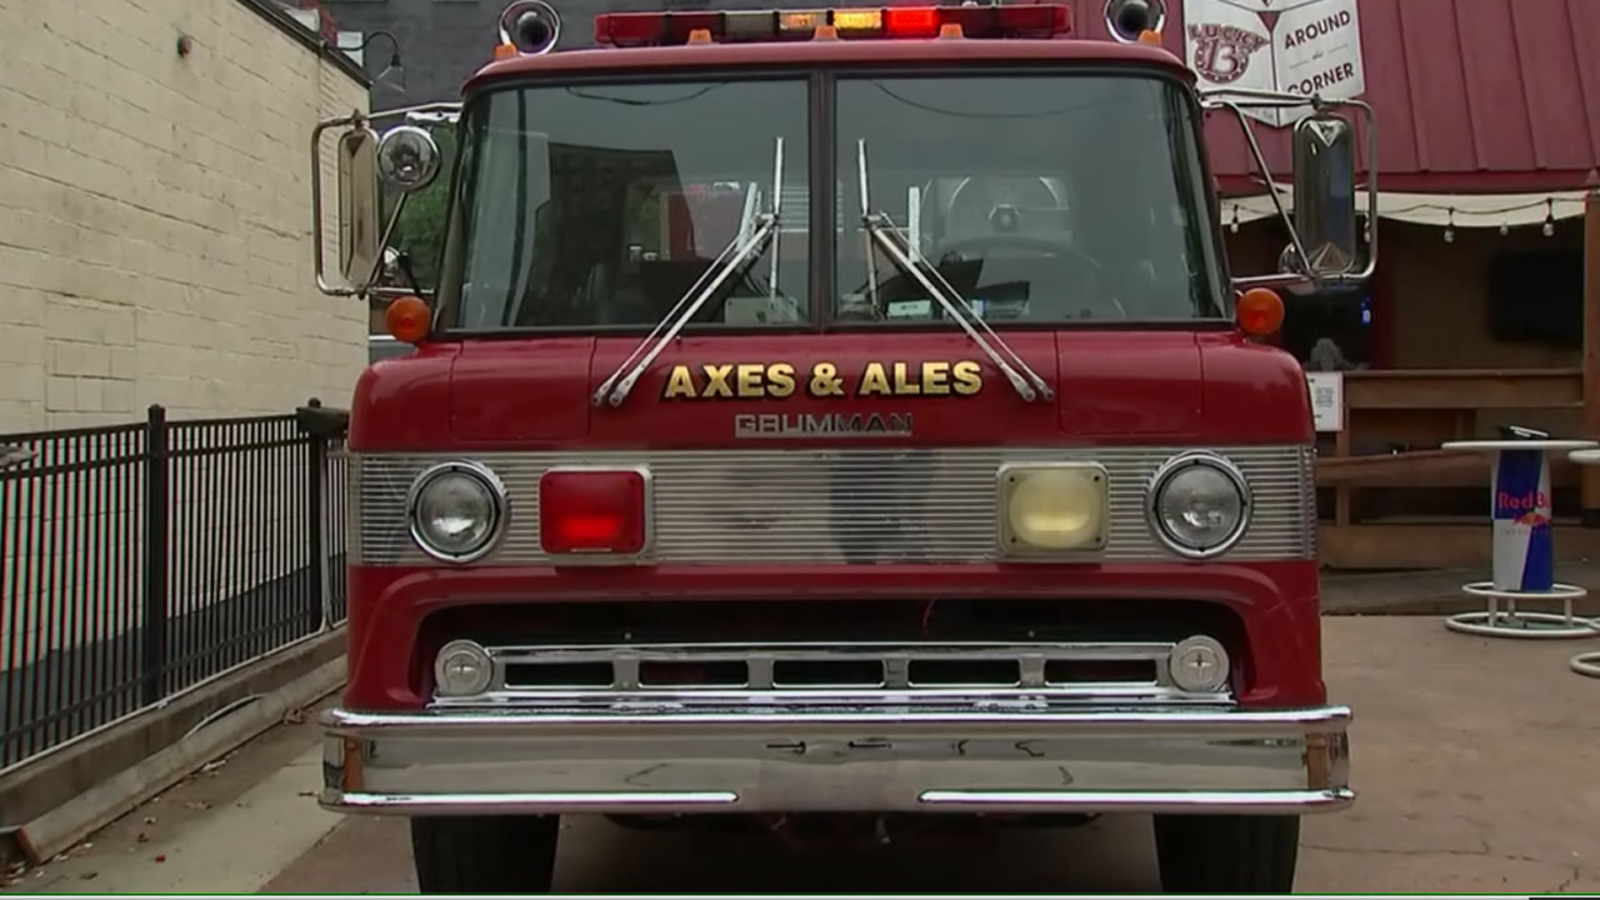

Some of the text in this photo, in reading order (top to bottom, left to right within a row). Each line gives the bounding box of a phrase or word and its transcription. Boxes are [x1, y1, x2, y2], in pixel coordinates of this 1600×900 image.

[1187, 22, 1270, 53] LUCKY
[1285, 10, 1351, 50] AROUND
[1202, 37, 1240, 76] 13
[663, 360, 983, 398] AXES & ALES
[735, 412, 912, 438] GRUMMAN
[1498, 491, 1534, 510] Red
